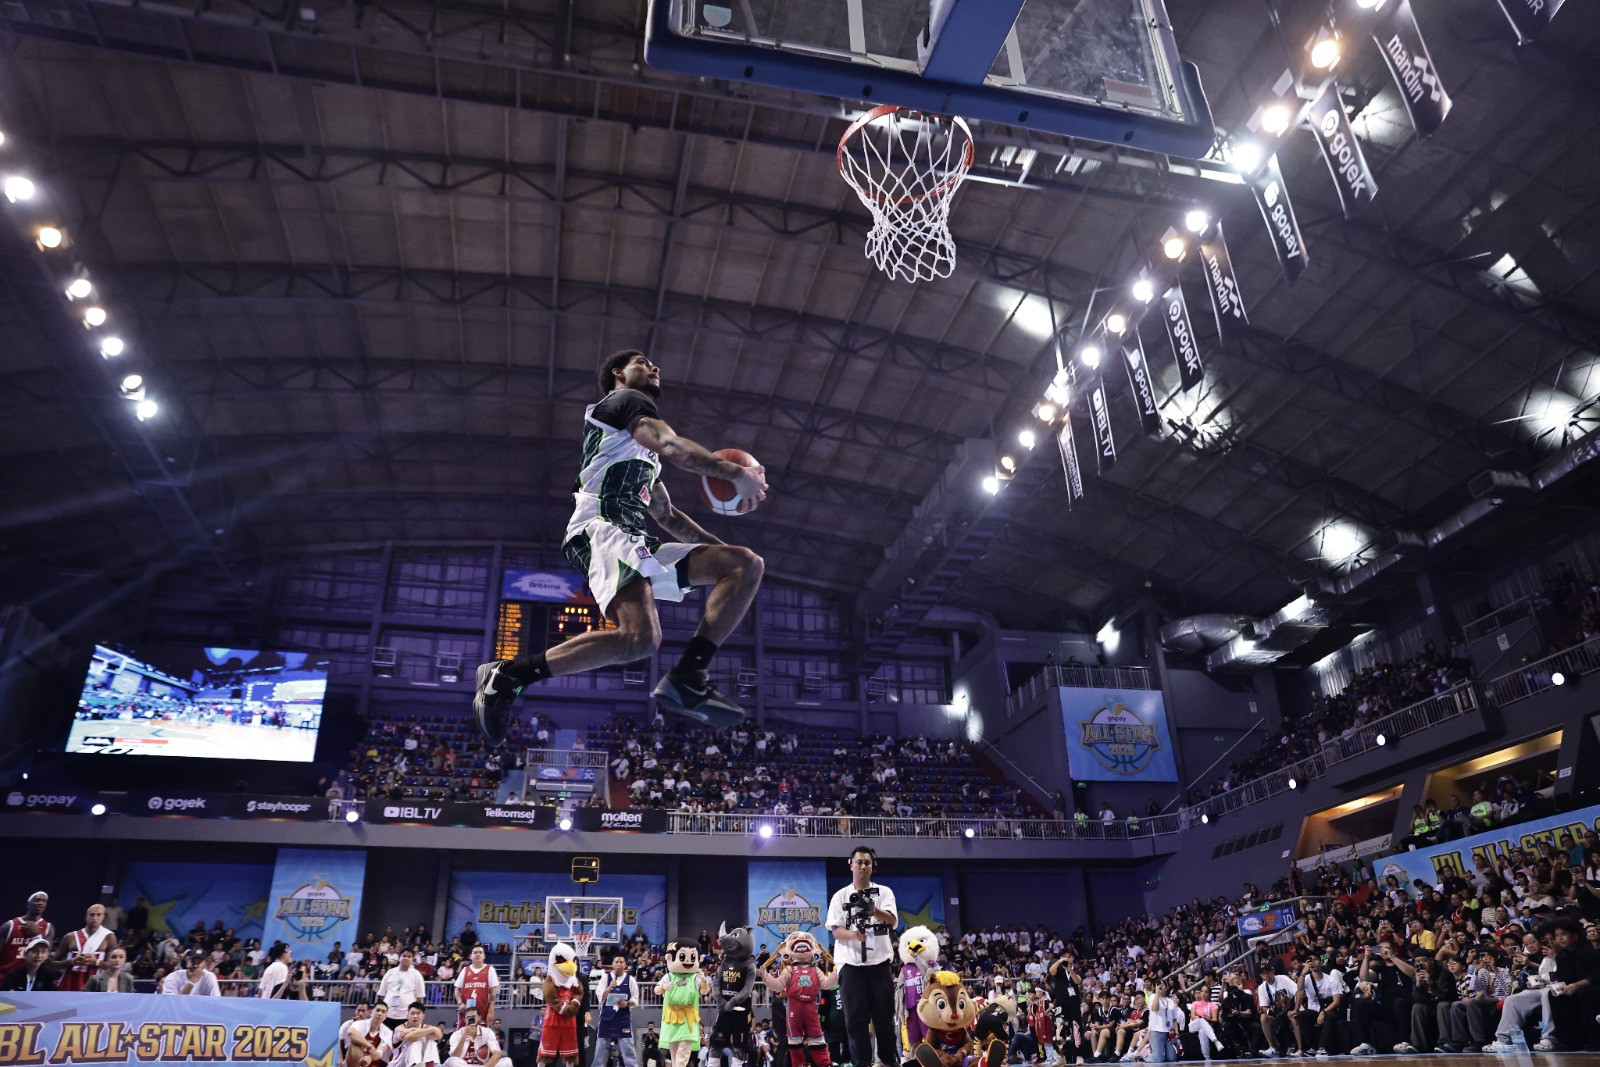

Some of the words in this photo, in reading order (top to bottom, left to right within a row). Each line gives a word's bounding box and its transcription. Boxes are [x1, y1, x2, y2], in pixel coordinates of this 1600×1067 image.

[1329, 132, 1366, 199] gojek
[1271, 203, 1301, 259] gopay
[1173, 319, 1198, 376] gojek
[1134, 368, 1155, 416] gopay
[27, 794, 77, 807] gopay
[164, 798, 206, 810] gojek
[256, 801, 309, 812] stayhoops
[484, 808, 535, 819] Telkomsel
[601, 811, 642, 822] molten
[478, 901, 566, 929] Brighter
[569, 902, 637, 926] Future
[1282, 914, 1293, 926] 1D
[230, 1024, 311, 1063] 2025
